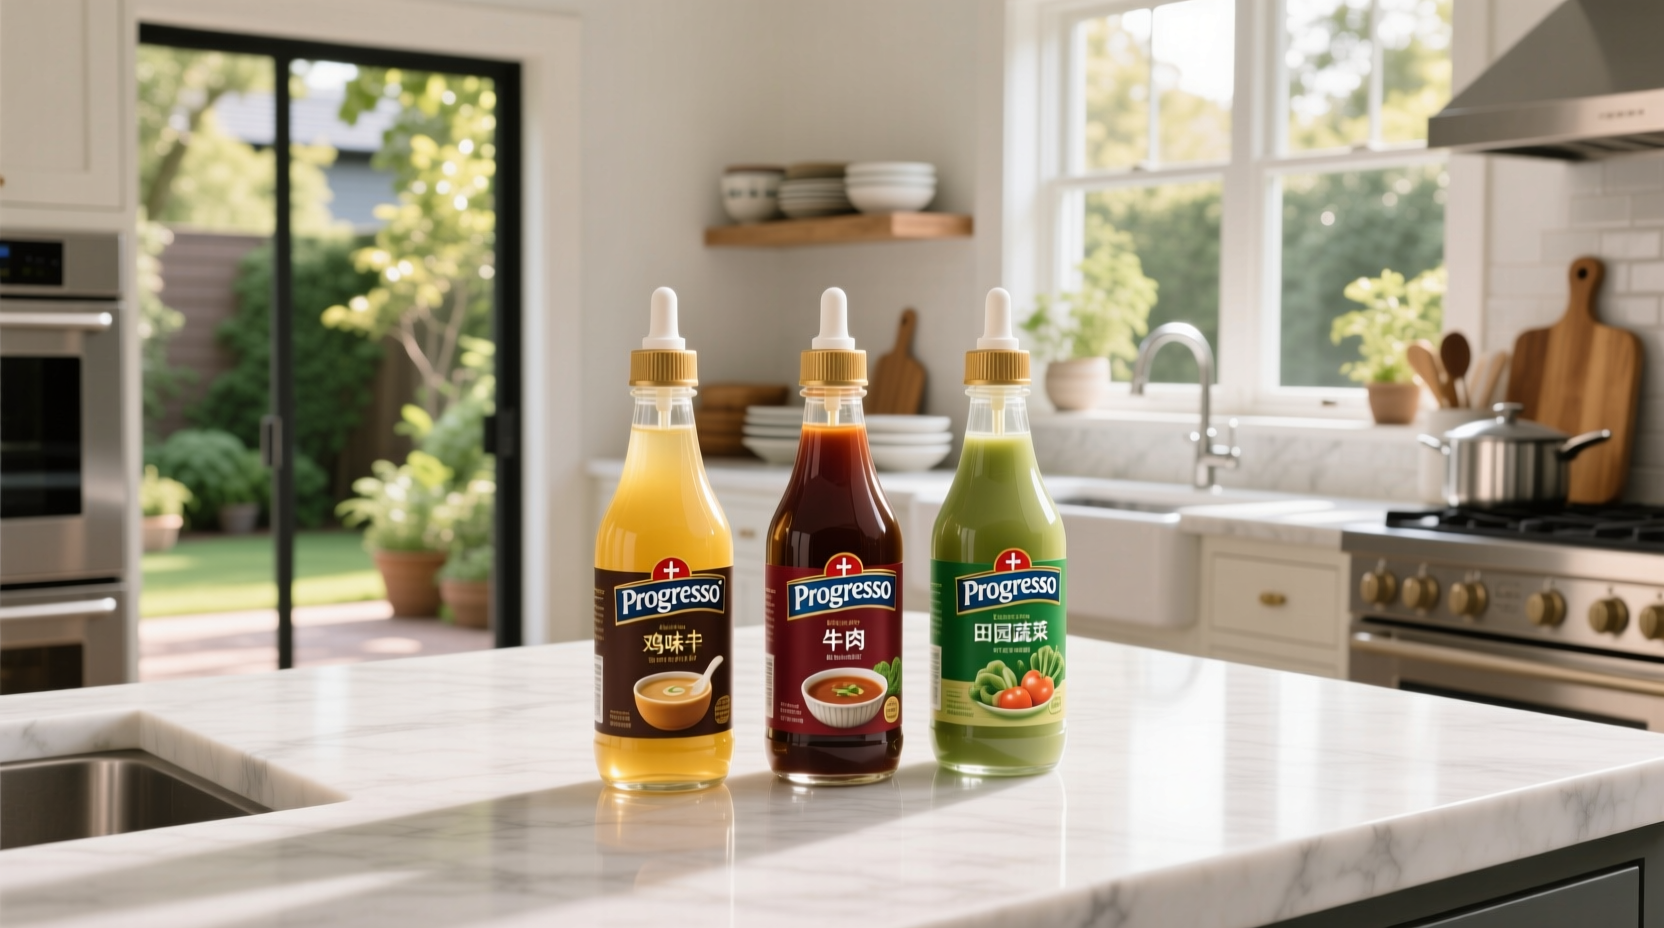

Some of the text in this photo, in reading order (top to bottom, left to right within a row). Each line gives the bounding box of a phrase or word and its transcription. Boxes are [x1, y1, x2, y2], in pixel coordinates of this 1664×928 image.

[621, 584, 721, 615] Progresso
[794, 580, 892, 611] Progresso
[963, 576, 1057, 606] Progresso
[822, 627, 865, 652] 牛肉
